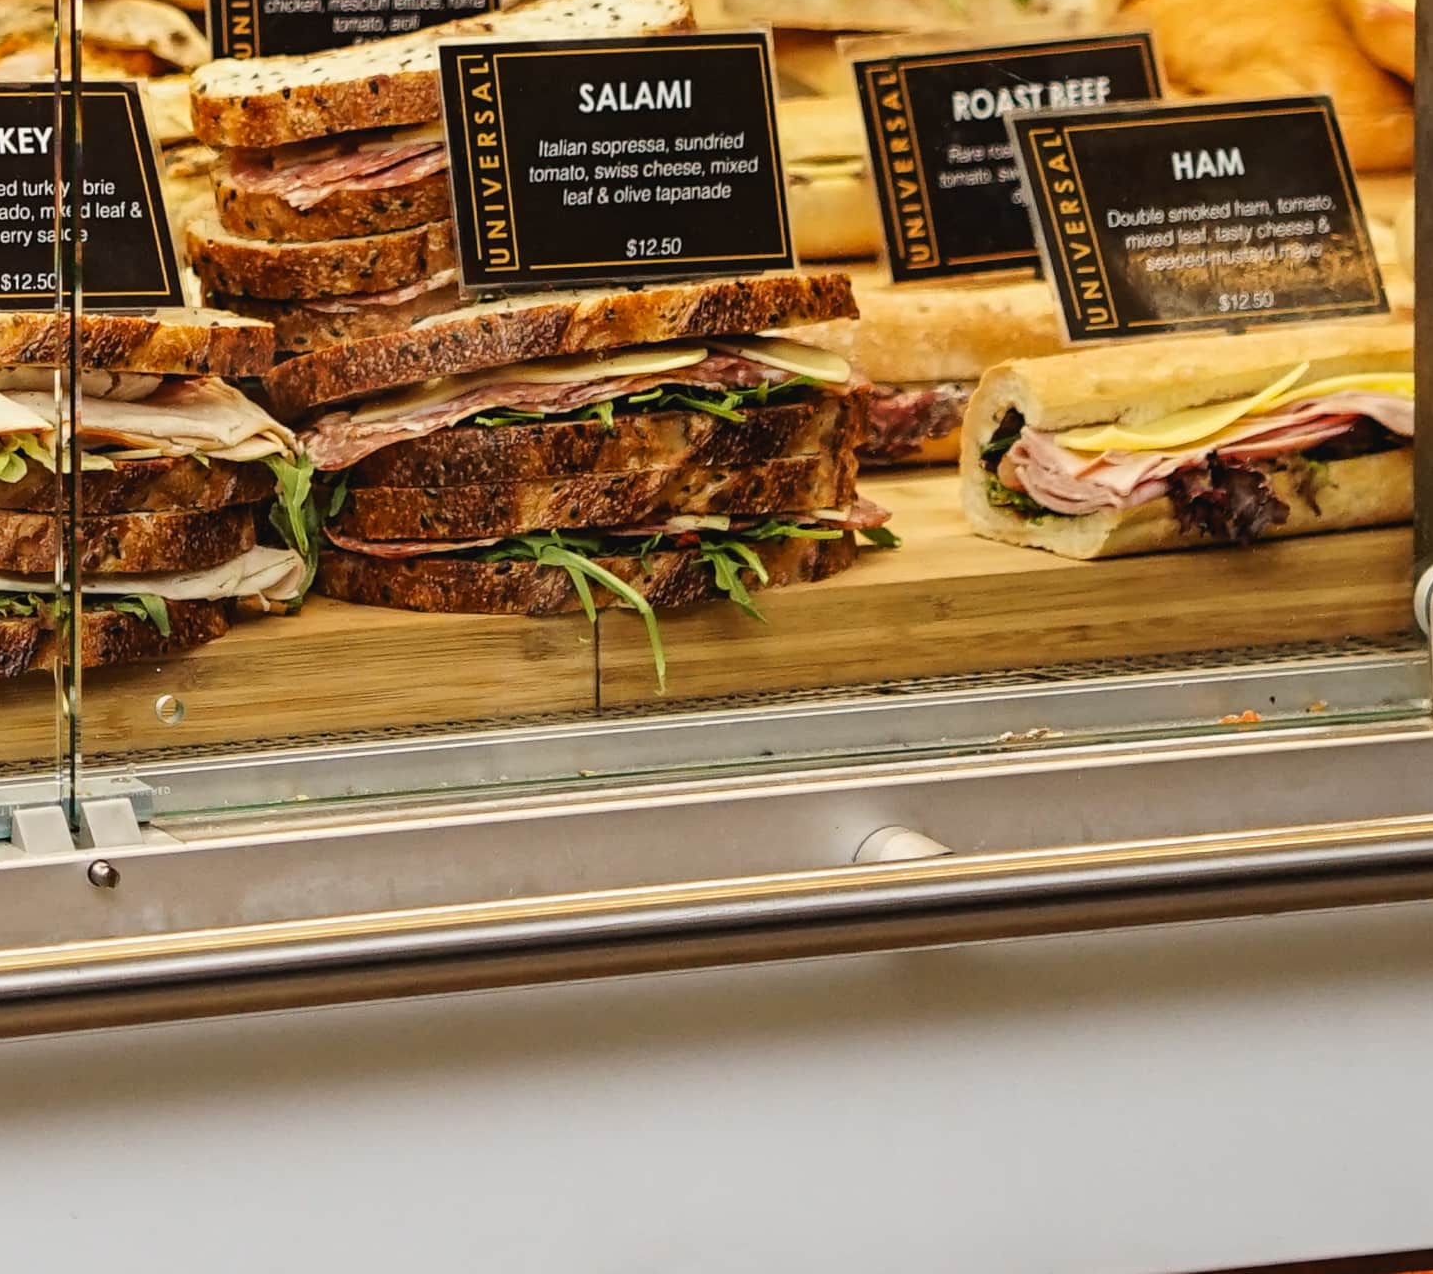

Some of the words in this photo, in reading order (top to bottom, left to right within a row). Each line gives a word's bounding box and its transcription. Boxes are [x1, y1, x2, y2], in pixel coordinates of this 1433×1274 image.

[332, 16, 386, 33] tomato,
[578, 78, 692, 113] SALAMI
[951, 83, 1044, 122] ROAST
[1047, 75, 1111, 111] BEEF
[538, 138, 588, 158] Italian
[591, 137, 670, 158] sopressa,
[674, 132, 745, 152] sundried
[469, 62, 511, 265] UNIVERSAL
[528, 166, 590, 184] tomato,
[594, 163, 639, 180] swiss
[642, 160, 706, 179] cheese,
[710, 156, 759, 175] mixed
[877, 71, 931, 265] UNIVERSAL
[1171, 146, 1246, 181] HAM
[22, 179, 70, 199] turky
[82, 178, 116, 196] brie
[563, 188, 593, 207] leaf
[597, 187, 609, 204] &
[613, 185, 652, 203] olive
[655, 183, 732, 205] tapanade
[95, 202, 126, 219] leaf
[130, 202, 143, 219] &
[1106, 207, 1165, 229] Double
[1167, 202, 1231, 223] smoked
[1233, 199, 1273, 220] ham,
[1277, 193, 1337, 212] tomato,
[1042, 132, 1113, 326] UNIVERSAL
[1125, 227, 1175, 250] mixed
[1215, 222, 1254, 245] tasty
[1256, 218, 1314, 239] cheese
[1317, 215, 1331, 234] &
[626, 237, 683, 258] $12.50
[1279, 244, 1323, 266] mayo
[0, 272, 60, 292] $12.50
[1218, 290, 1275, 313] $12.50
